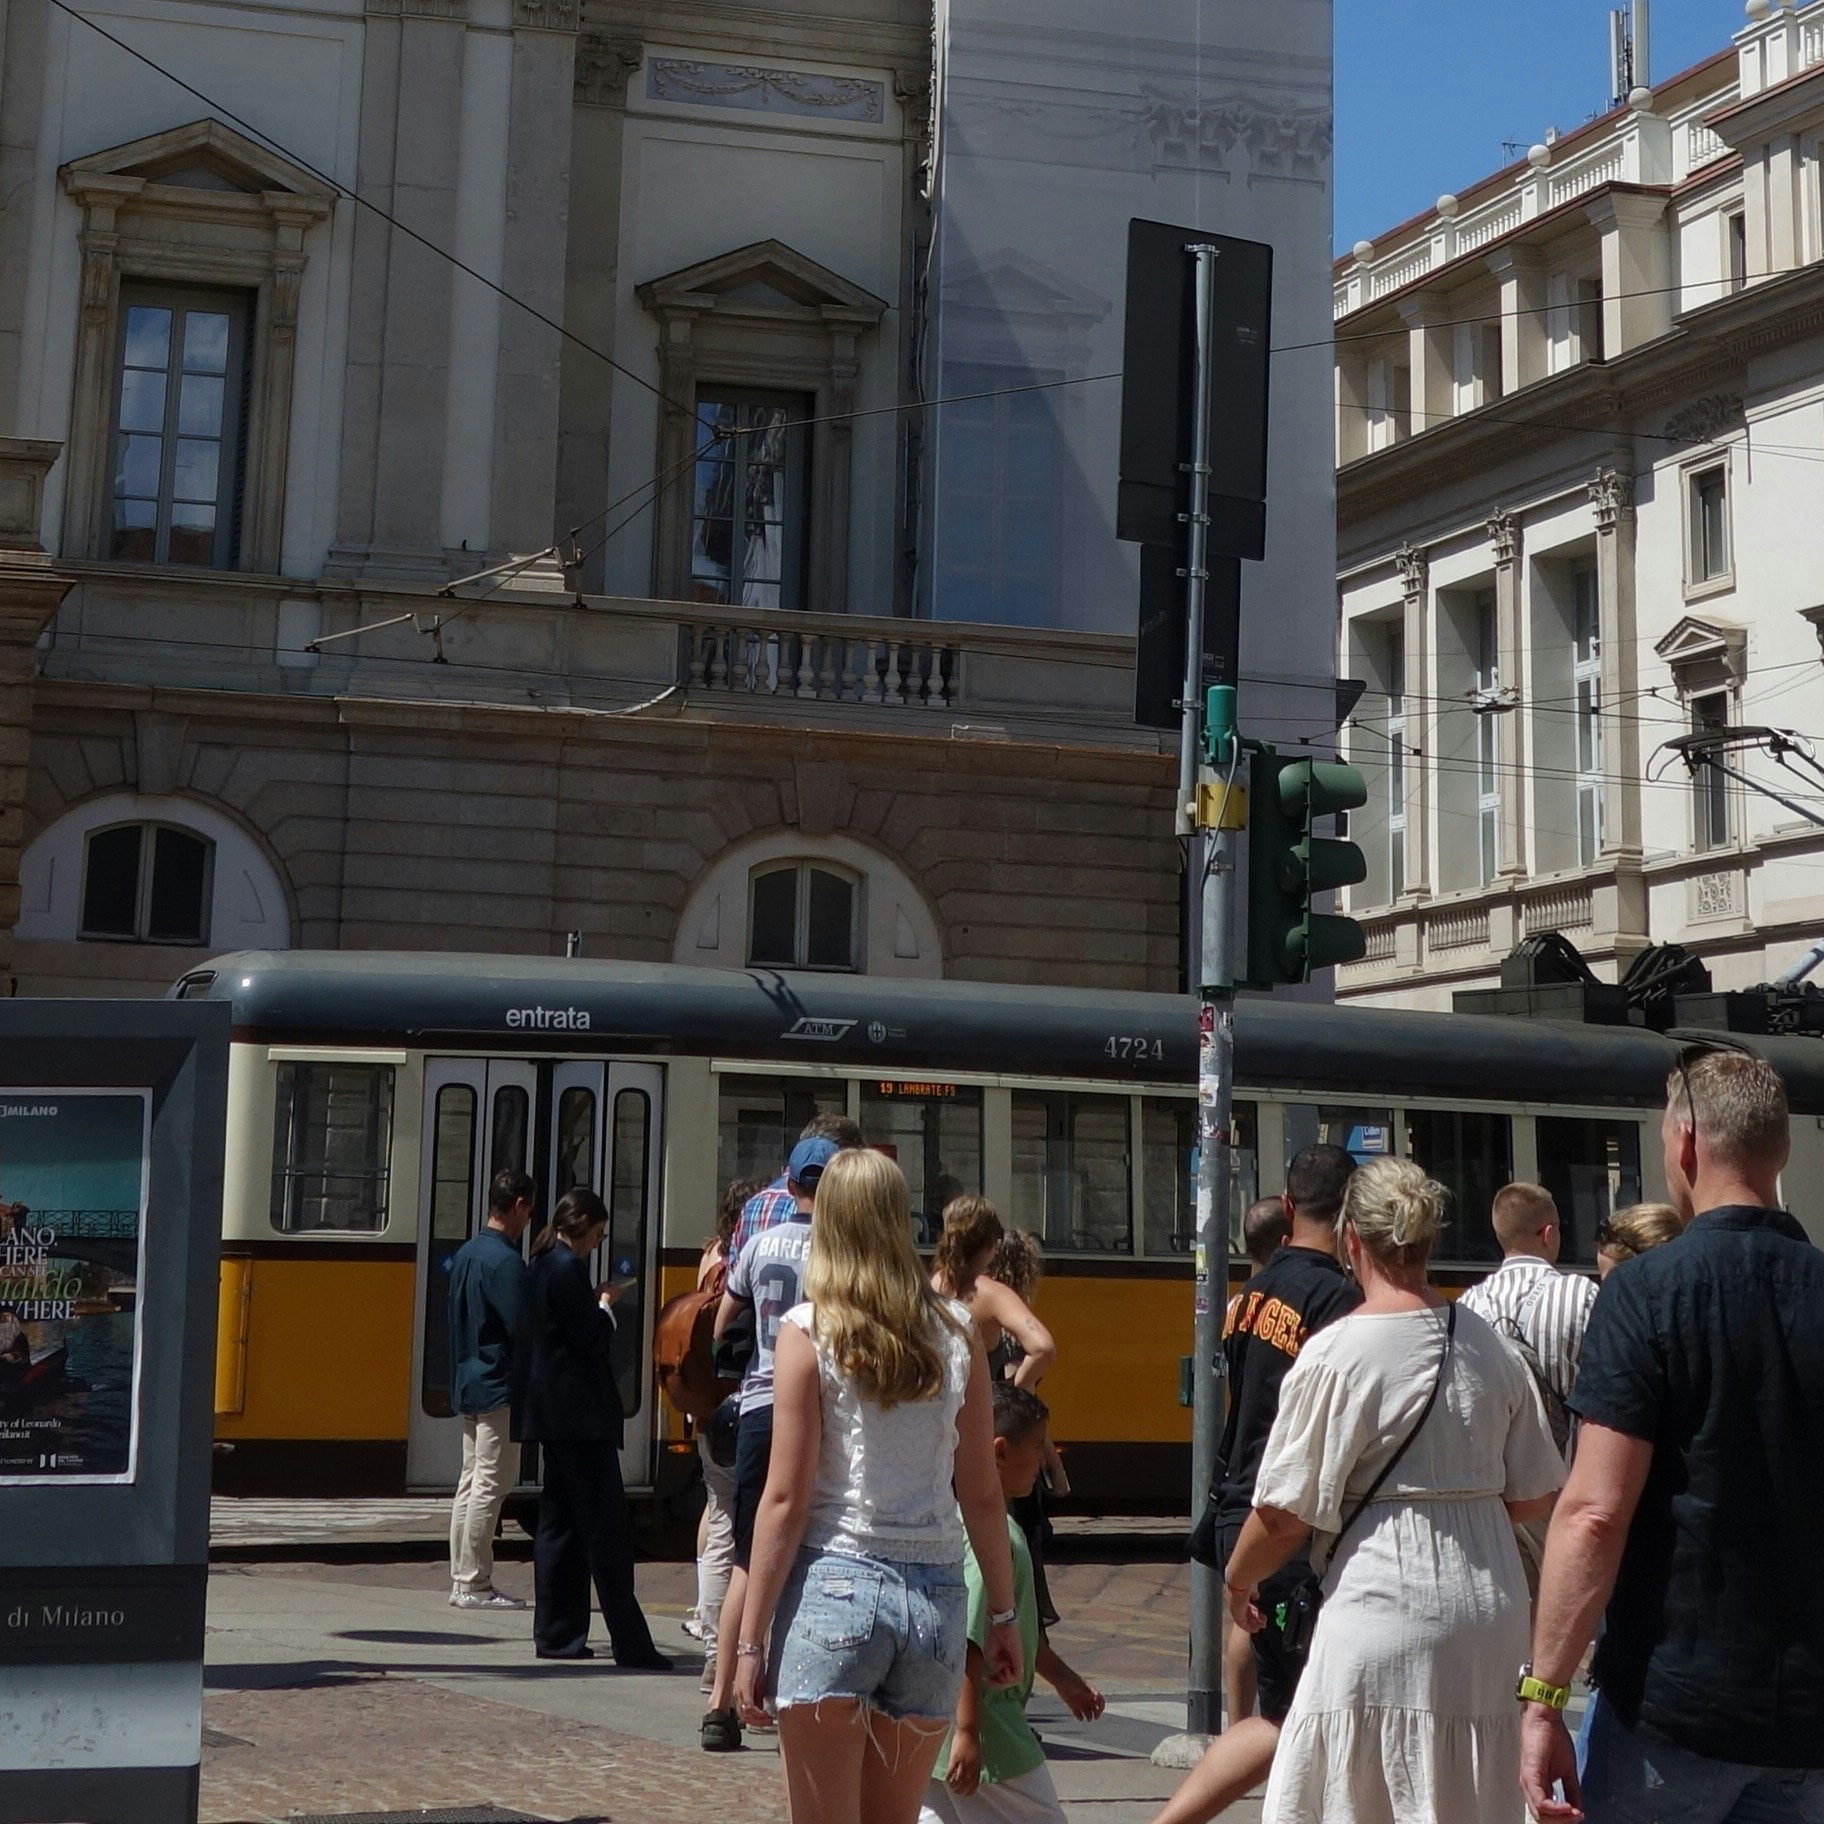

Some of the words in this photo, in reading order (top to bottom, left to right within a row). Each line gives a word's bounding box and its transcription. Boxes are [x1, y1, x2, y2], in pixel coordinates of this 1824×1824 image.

[505, 1006, 591, 1030] entrata
[803, 1023, 835, 1036] ATM
[1104, 1036, 1164, 1061] 4724
[880, 1082, 893, 1094] 19
[758, 1236, 810, 1262] BARCE
[0, 1265, 26, 1277] CAN
[10, 1418, 20, 1428] of
[21, 1418, 61, 1428] Leonardo
[7, 1606, 30, 1628] di
[41, 1605, 125, 1627] Milano
